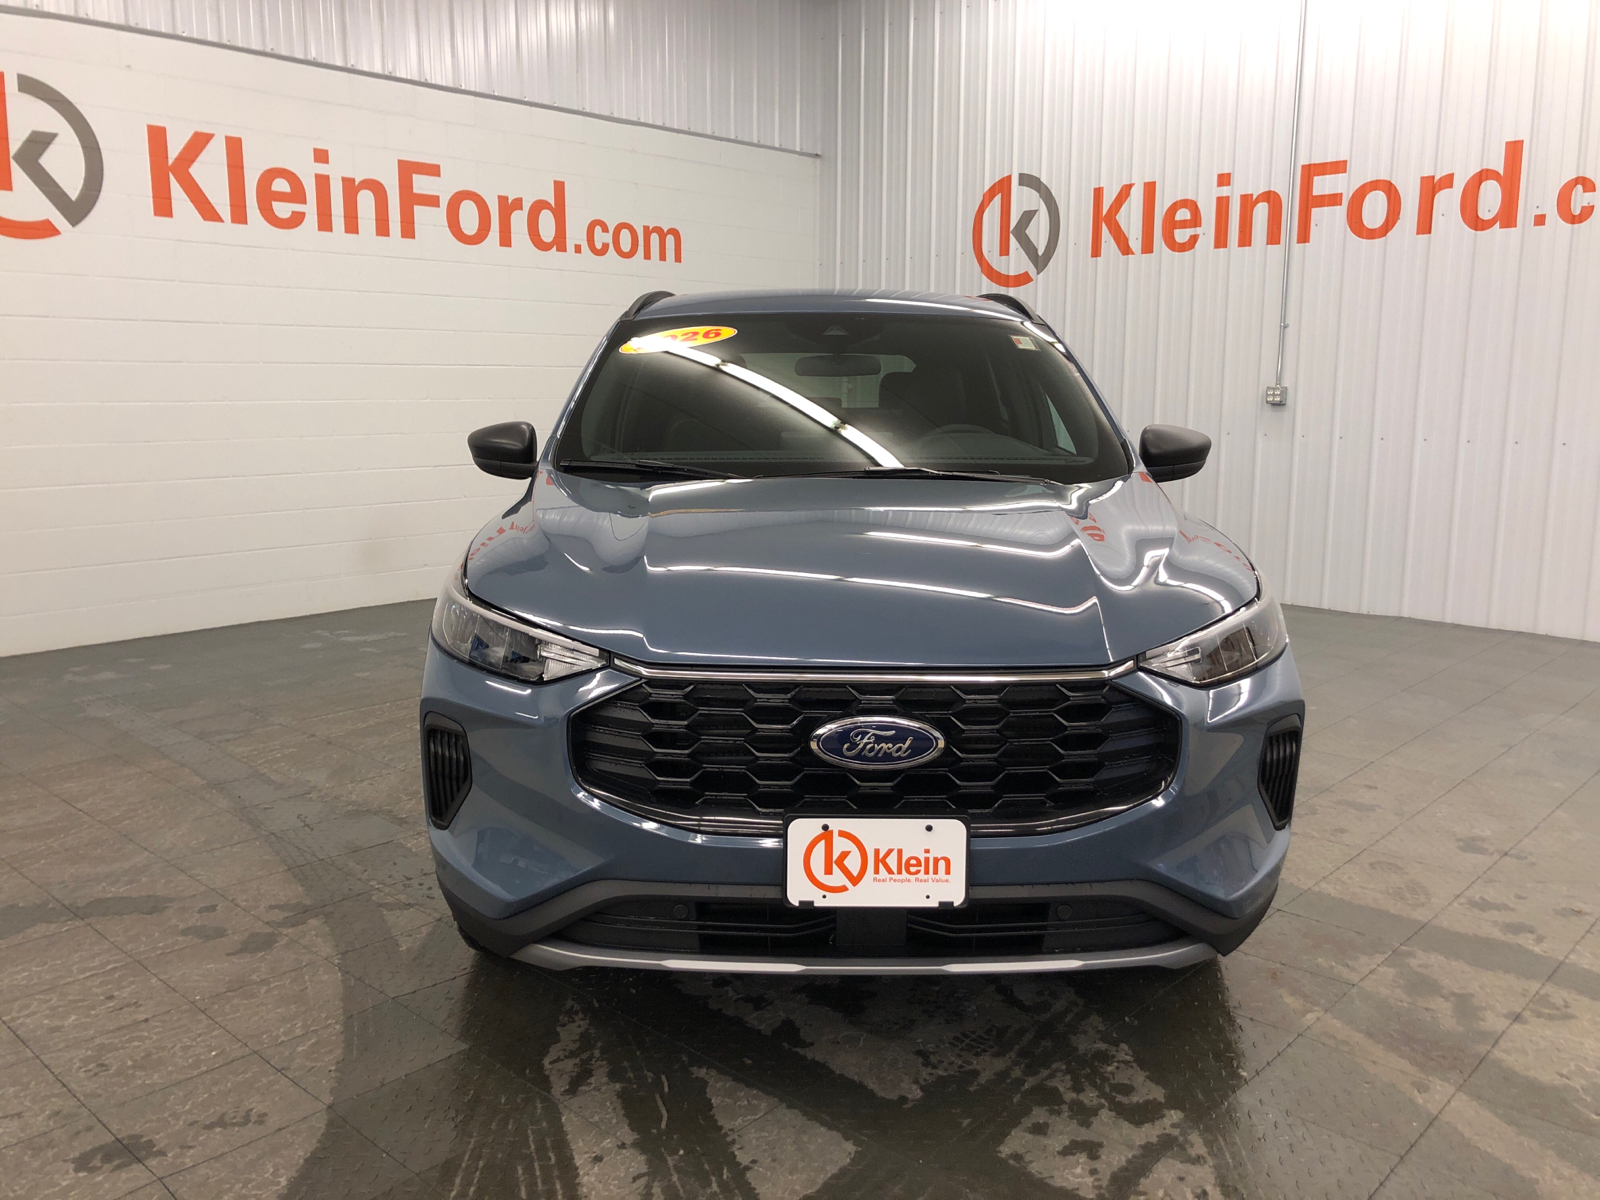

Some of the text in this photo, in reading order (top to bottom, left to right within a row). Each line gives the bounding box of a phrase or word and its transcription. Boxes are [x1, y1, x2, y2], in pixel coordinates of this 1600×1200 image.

[146, 123, 682, 264] KleinFord.com
[1090, 139, 1597, 259] KleinFord.c
[842, 728, 914, 758] Ford
[873, 848, 951, 875] Klein
